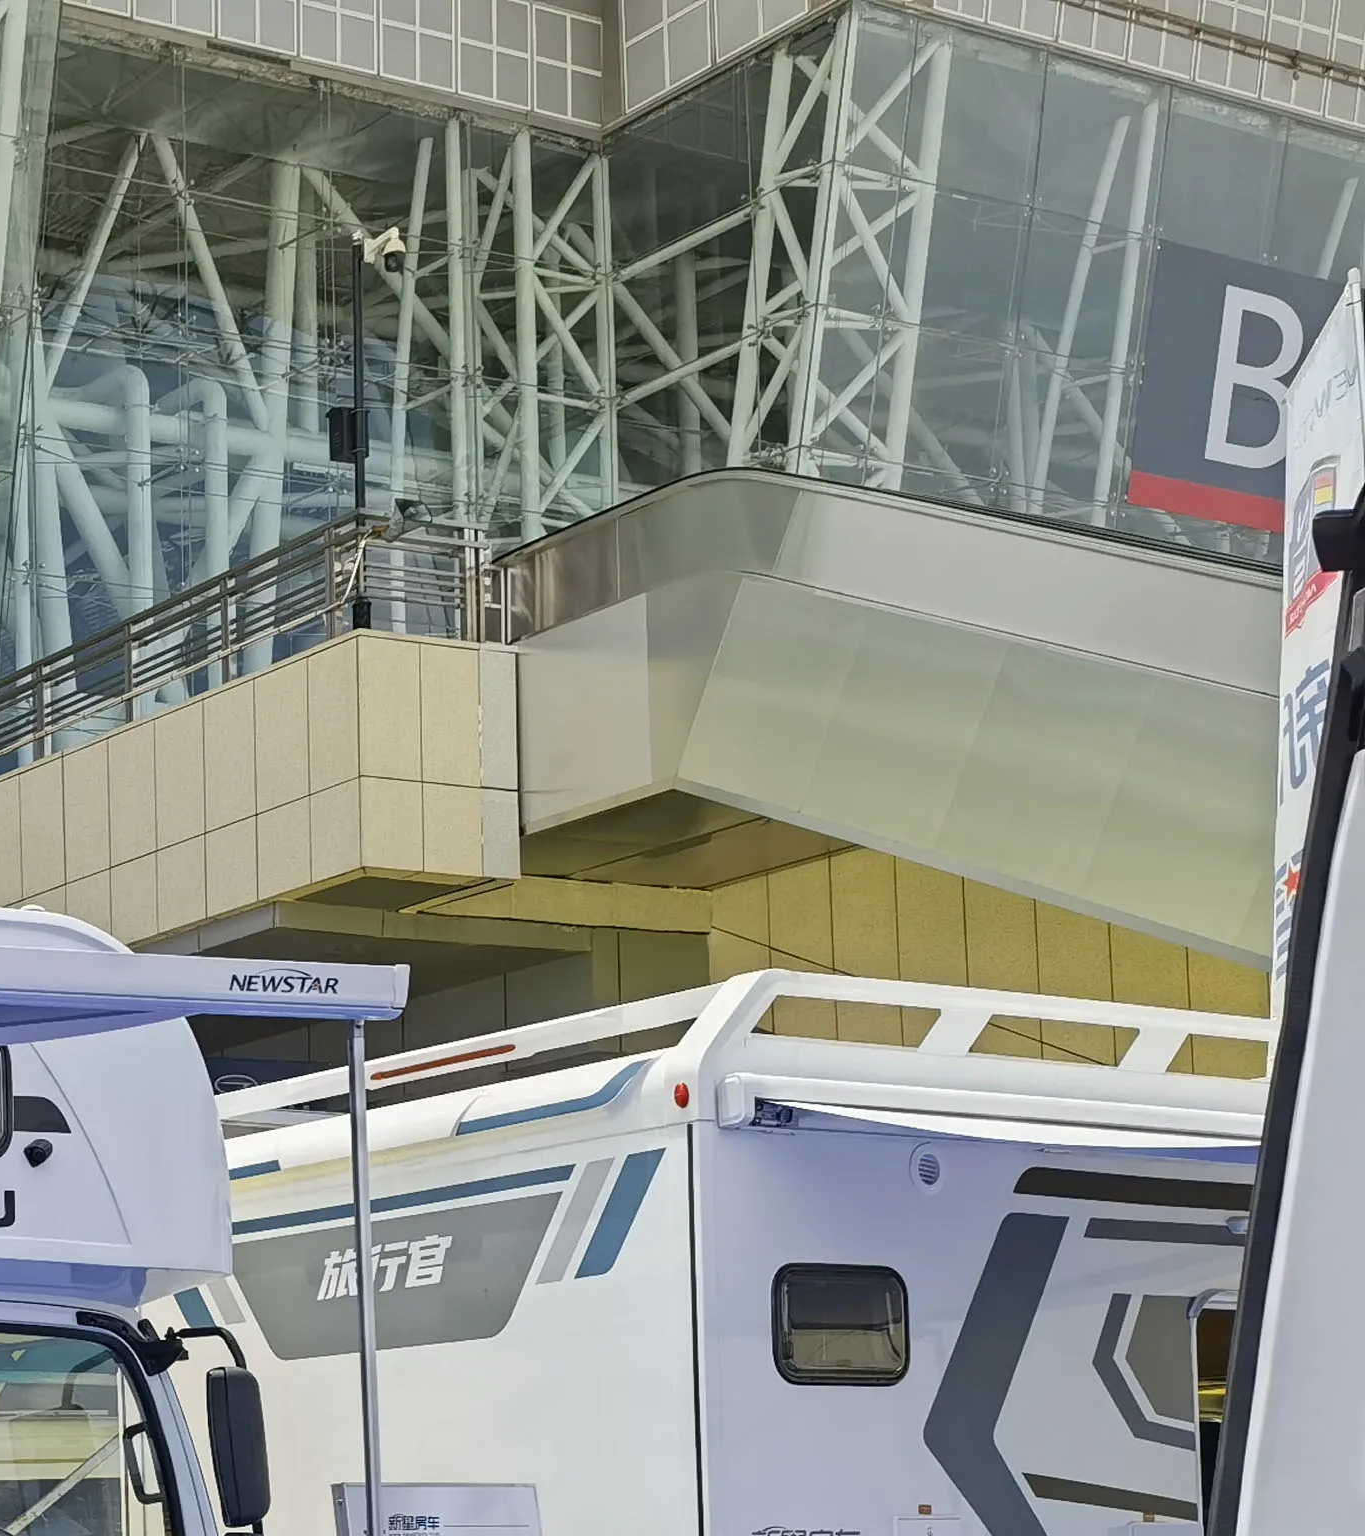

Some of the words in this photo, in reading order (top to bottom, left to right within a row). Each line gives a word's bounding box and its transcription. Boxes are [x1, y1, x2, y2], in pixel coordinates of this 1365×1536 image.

[1203, 284, 1303, 469] B
[229, 969, 339, 995] NEWSTAR
[317, 1235, 453, 1300] 旅行官
[388, 1514, 441, 1531] 新星房车
